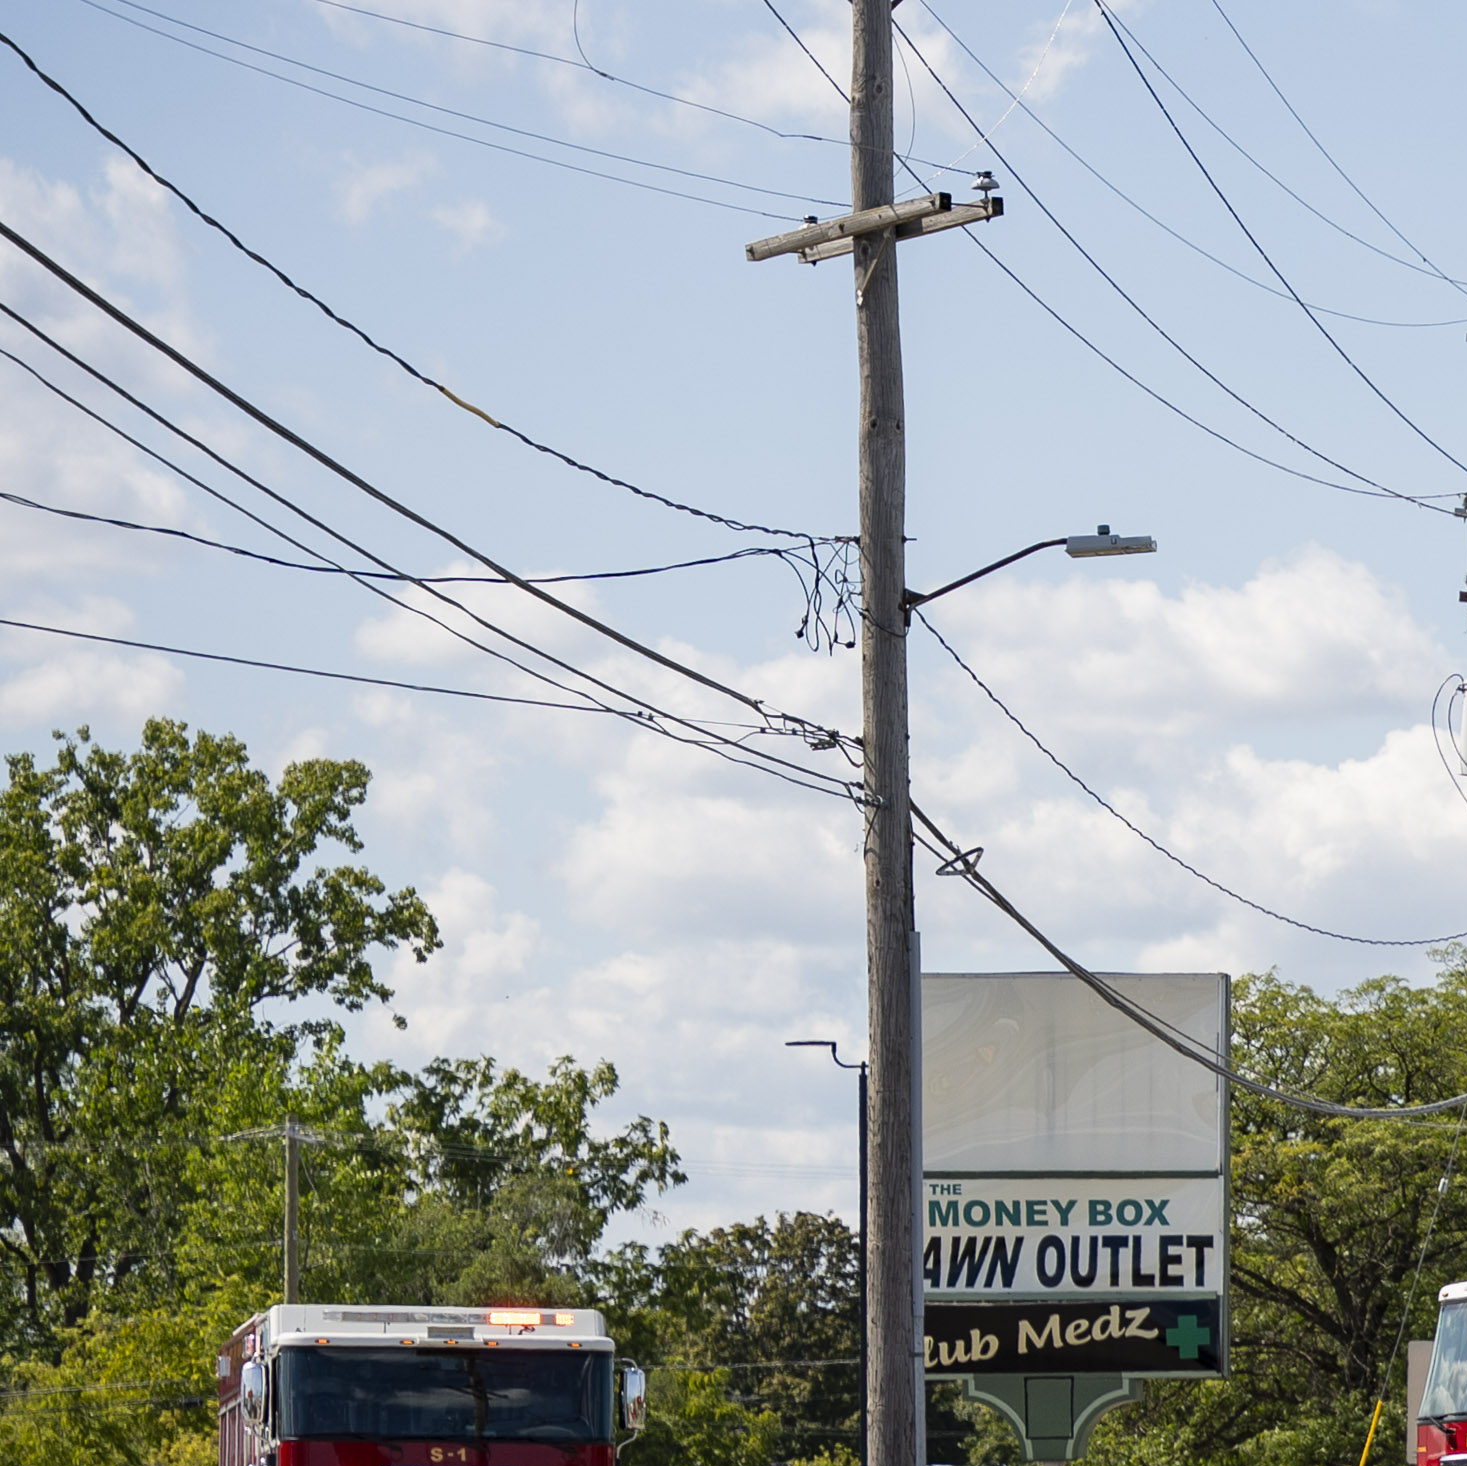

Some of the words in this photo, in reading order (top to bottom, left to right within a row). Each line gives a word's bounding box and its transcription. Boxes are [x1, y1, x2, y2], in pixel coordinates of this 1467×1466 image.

[929, 1183, 962, 1196] THE
[928, 1199, 1078, 1227] MONEY
[1088, 1199, 1170, 1226] BOX
[1036, 1234, 1214, 1288] OUTLET
[1017, 1304, 1159, 1354] Medz
